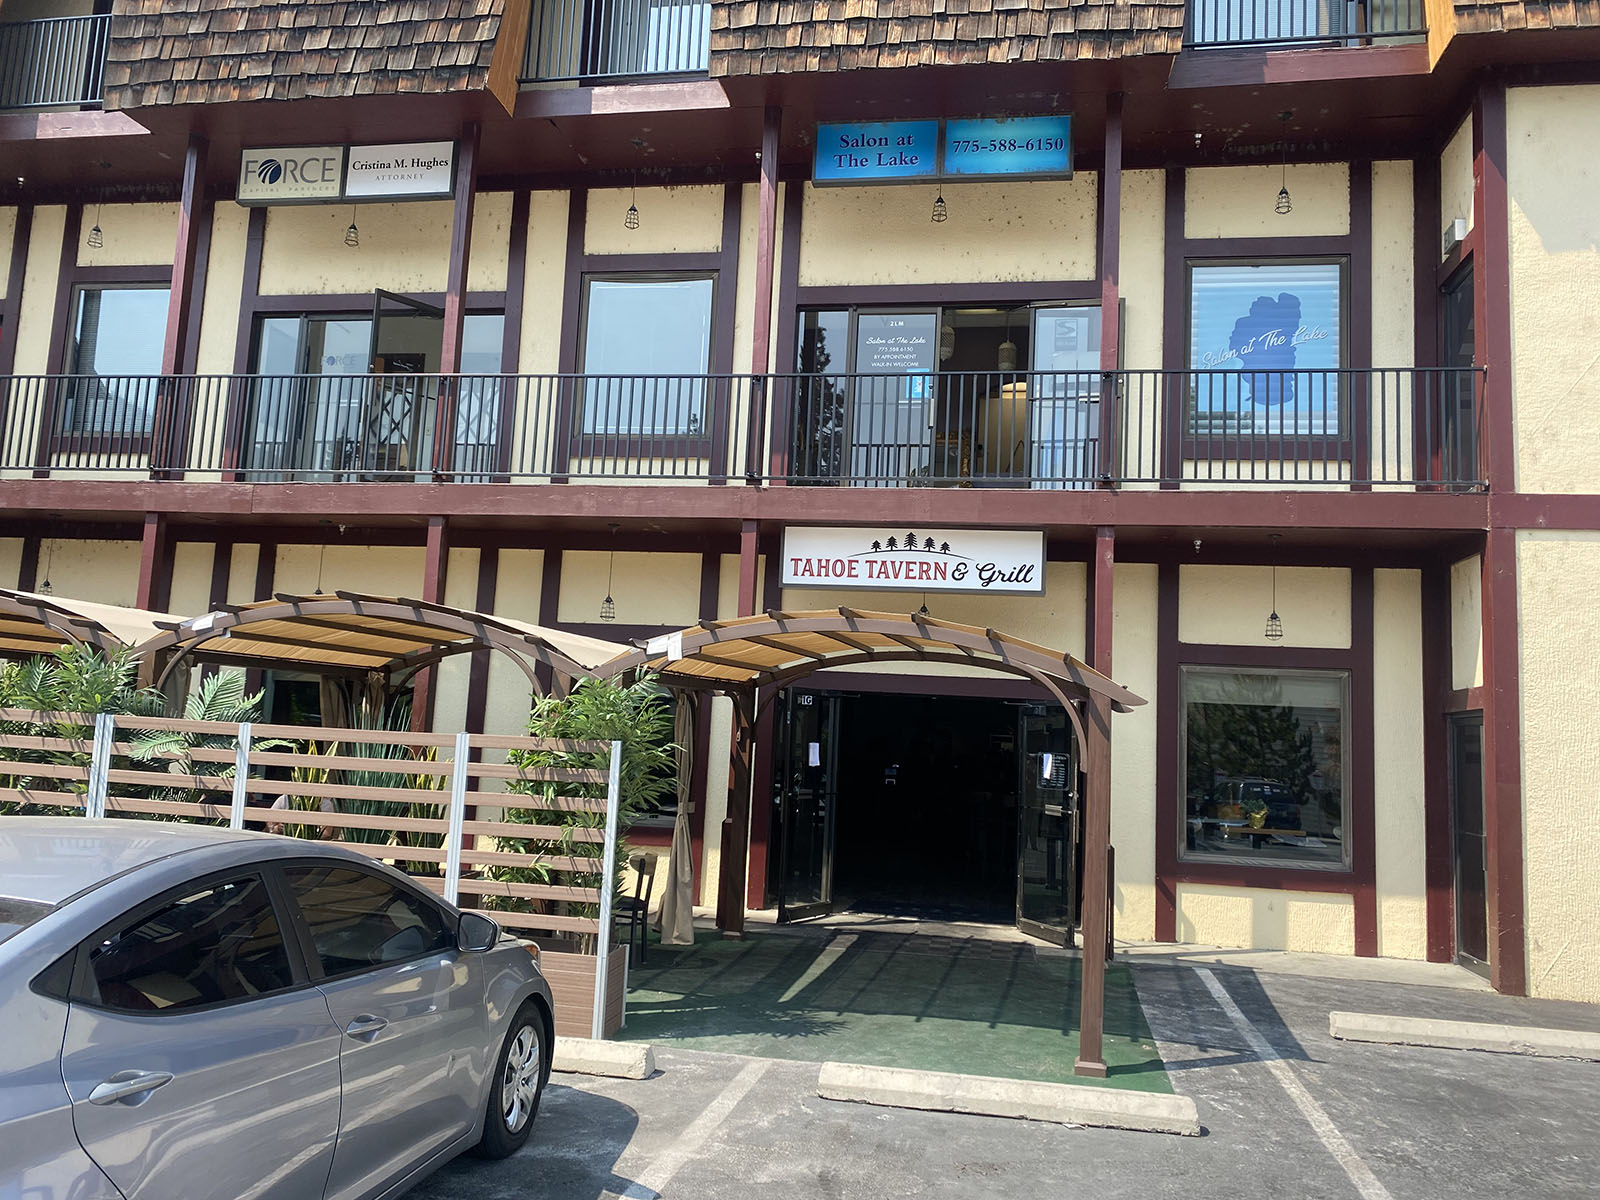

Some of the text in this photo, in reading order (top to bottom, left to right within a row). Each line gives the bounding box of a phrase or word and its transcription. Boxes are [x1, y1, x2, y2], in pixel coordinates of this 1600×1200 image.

[840, 133, 914, 149] Salon at
[952, 137, 1064, 153] 775-588-6150
[352, 157, 449, 171] Cristina M. Hughes
[833, 151, 919, 168] The Lake
[243, 157, 336, 185] FORCE
[376, 173, 425, 181] ATTORNEY
[866, 336, 886, 344] Salon
[896, 336, 908, 344] The
[909, 336, 926, 344] Lake
[1202, 325, 1329, 369] Salon at The Lake
[790, 557, 1035, 588] TAHOE TAVERN & Grill
